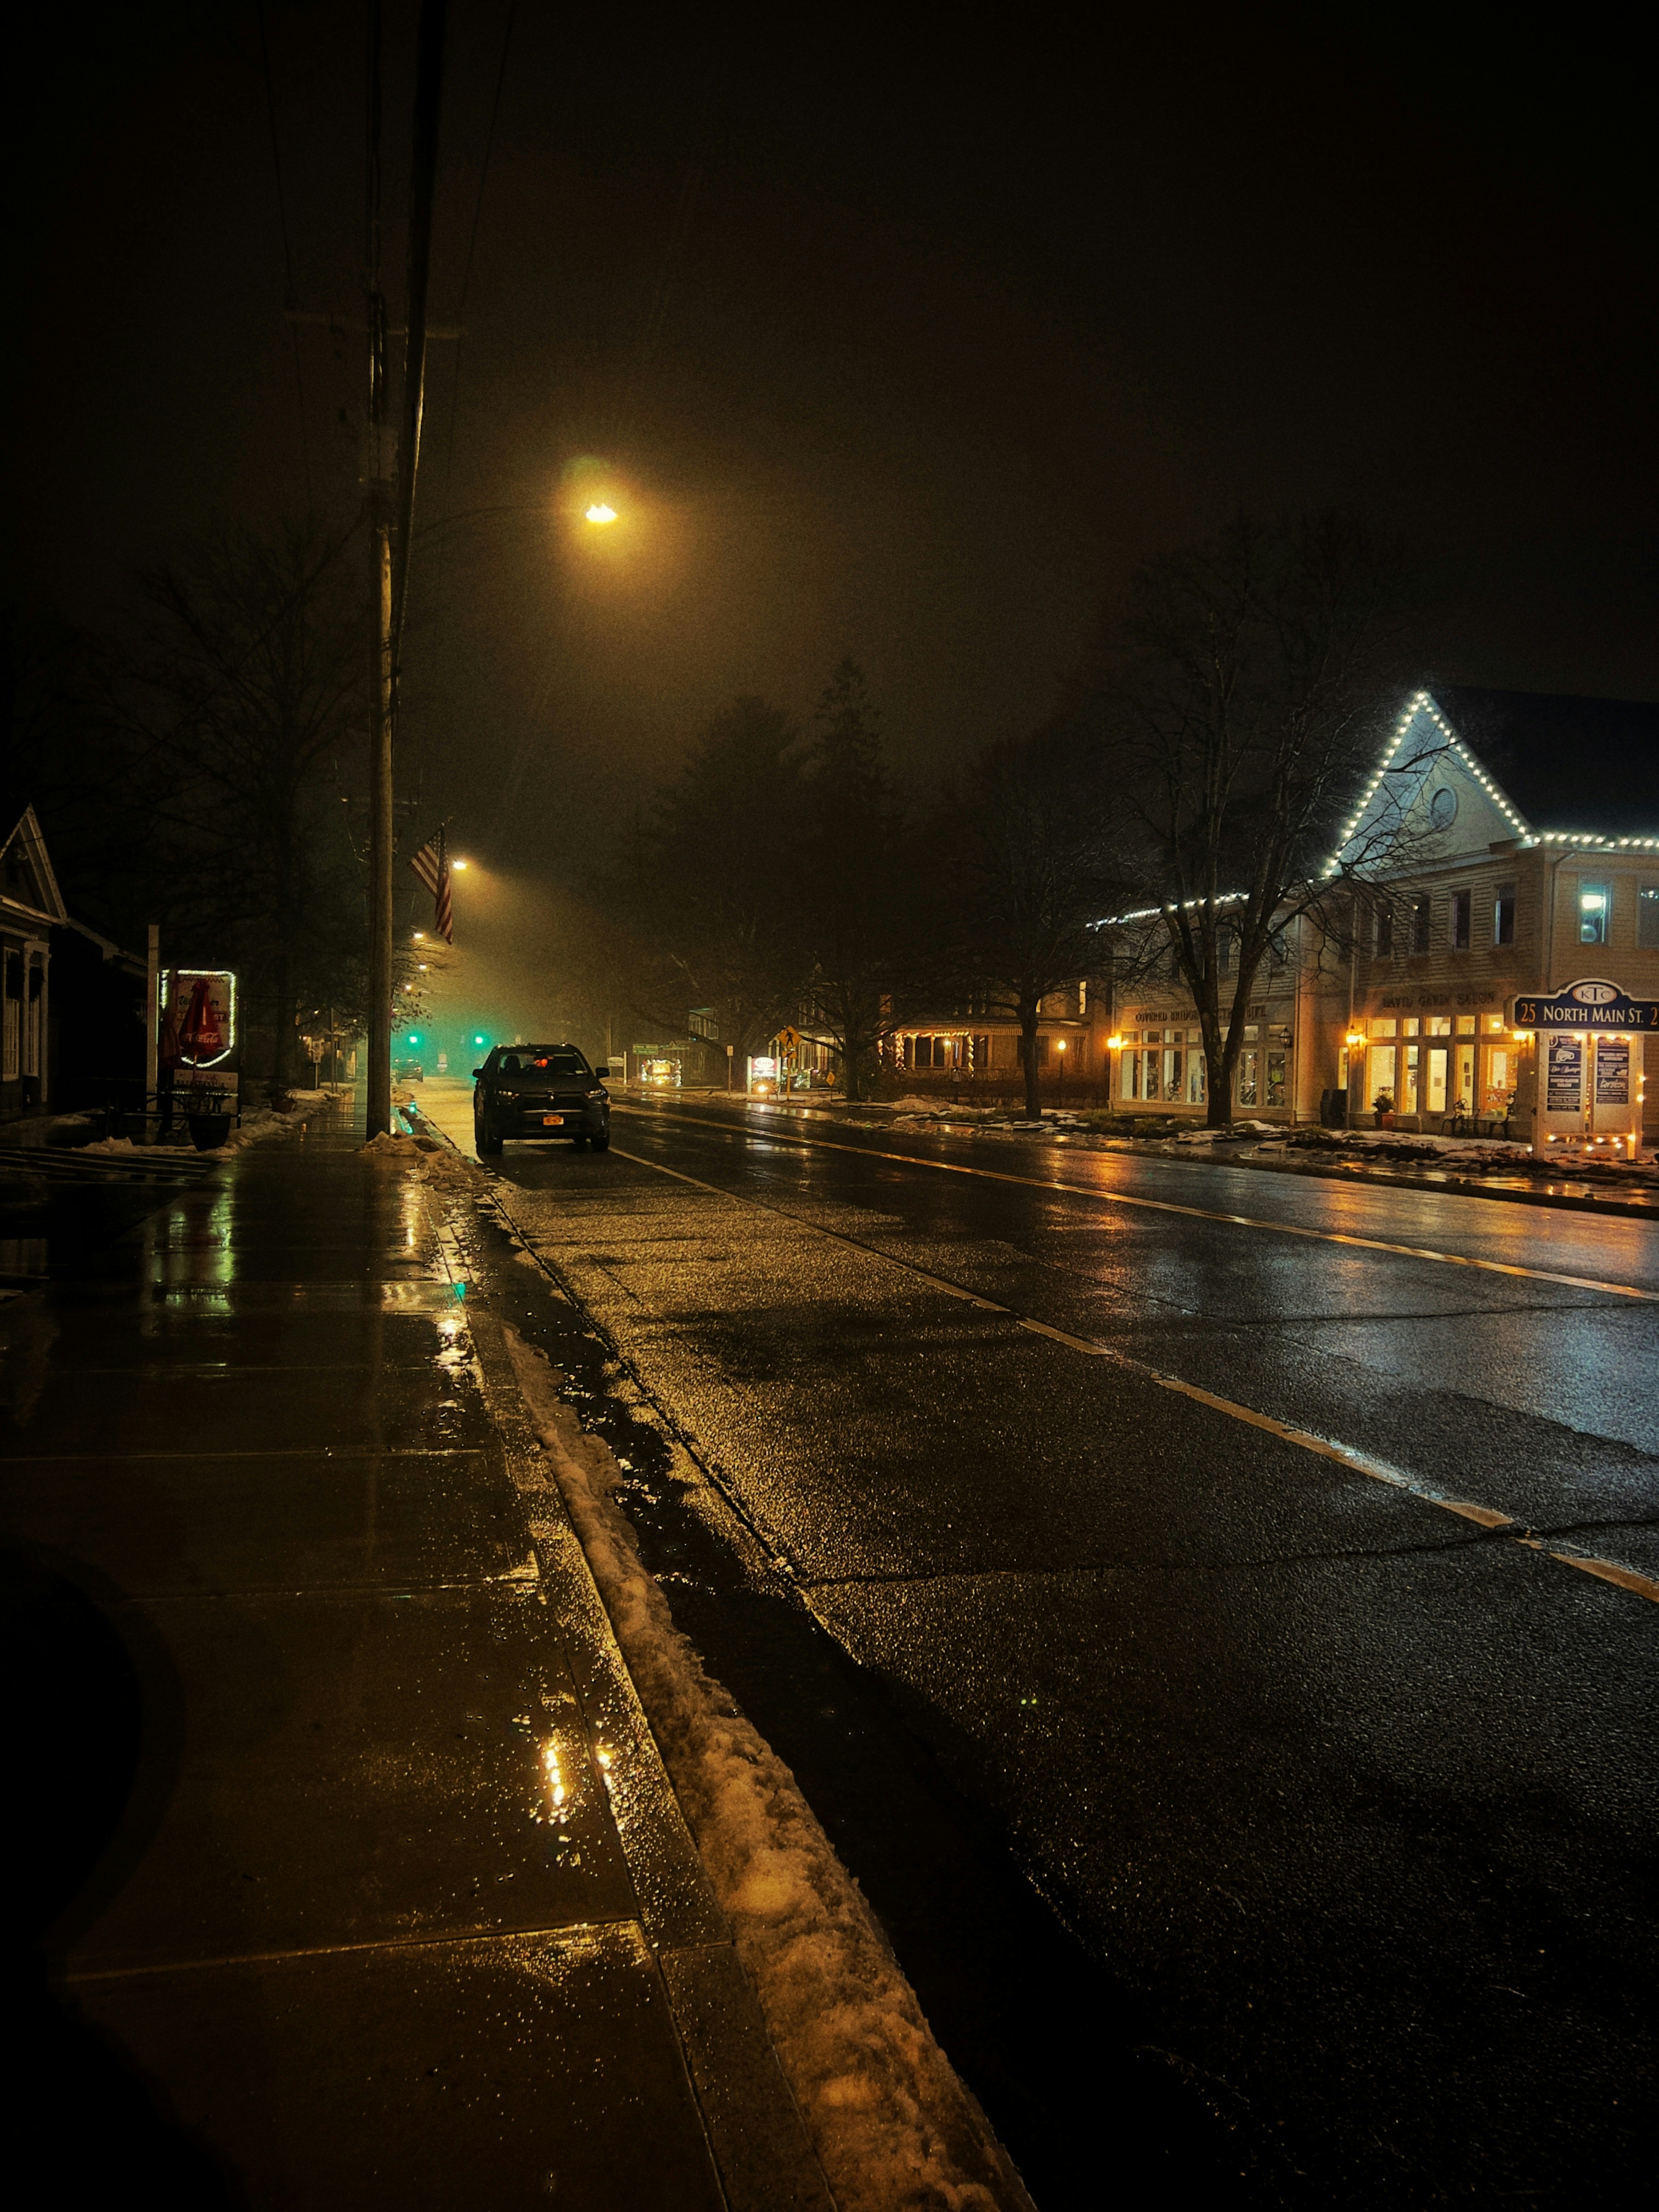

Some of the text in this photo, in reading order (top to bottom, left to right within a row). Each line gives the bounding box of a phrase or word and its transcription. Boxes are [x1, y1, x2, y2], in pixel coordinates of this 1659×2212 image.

[1457, 992, 1494, 1005] SALON
[1581, 986, 1611, 1001] KTC
[1136, 1011, 1167, 1023] COVERED
[1170, 1009, 1199, 1022] BRIDGE
[1521, 1003, 1536, 1023] 25
[1543, 1006, 1588, 1023] NORTH
[1592, 1006, 1626, 1023] MAIN
